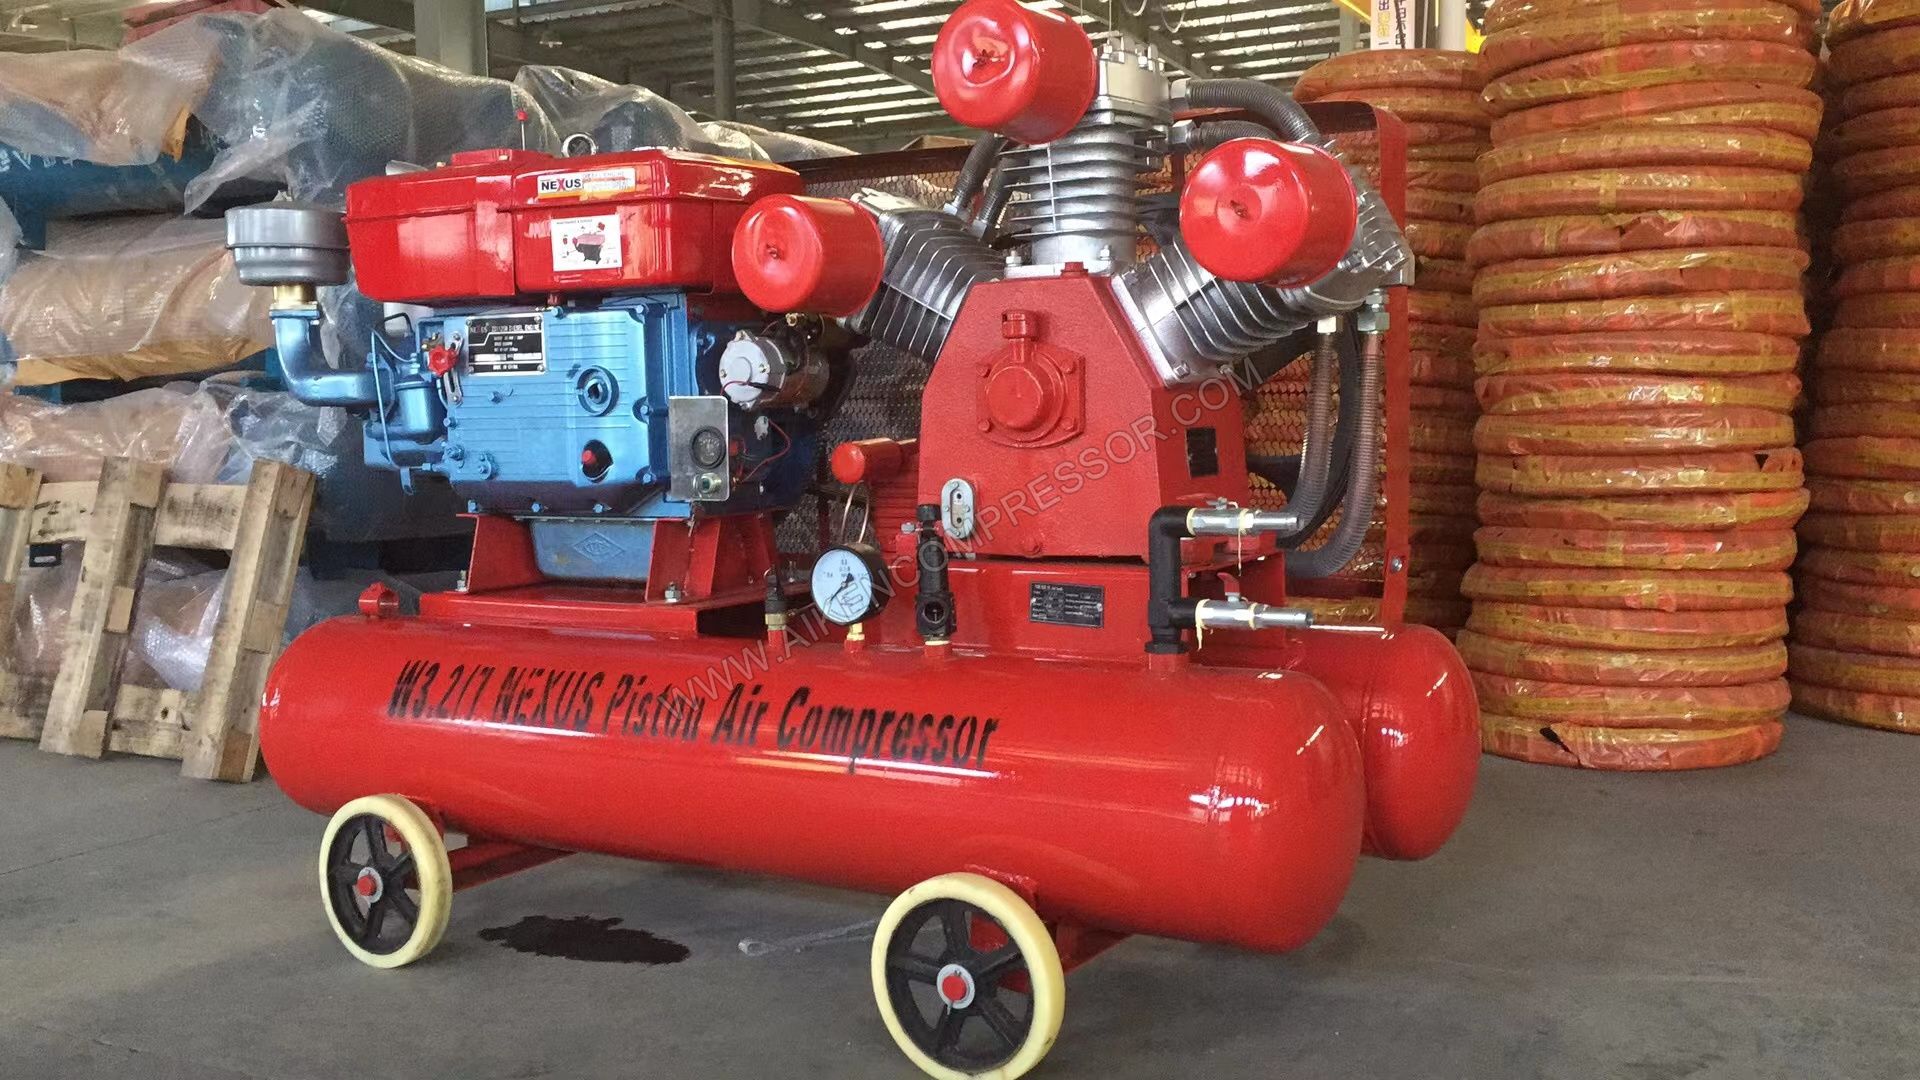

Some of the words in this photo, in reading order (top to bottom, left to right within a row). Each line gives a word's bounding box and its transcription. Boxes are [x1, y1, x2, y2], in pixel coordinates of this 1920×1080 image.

[541, 178, 582, 191] NEXUS
[387, 659, 496, 720] W3.2/7
[493, 666, 605, 732] NEXUS
[601, 673, 704, 742] Piston
[710, 683, 768, 746] Air
[777, 686, 999, 775] Compressor
